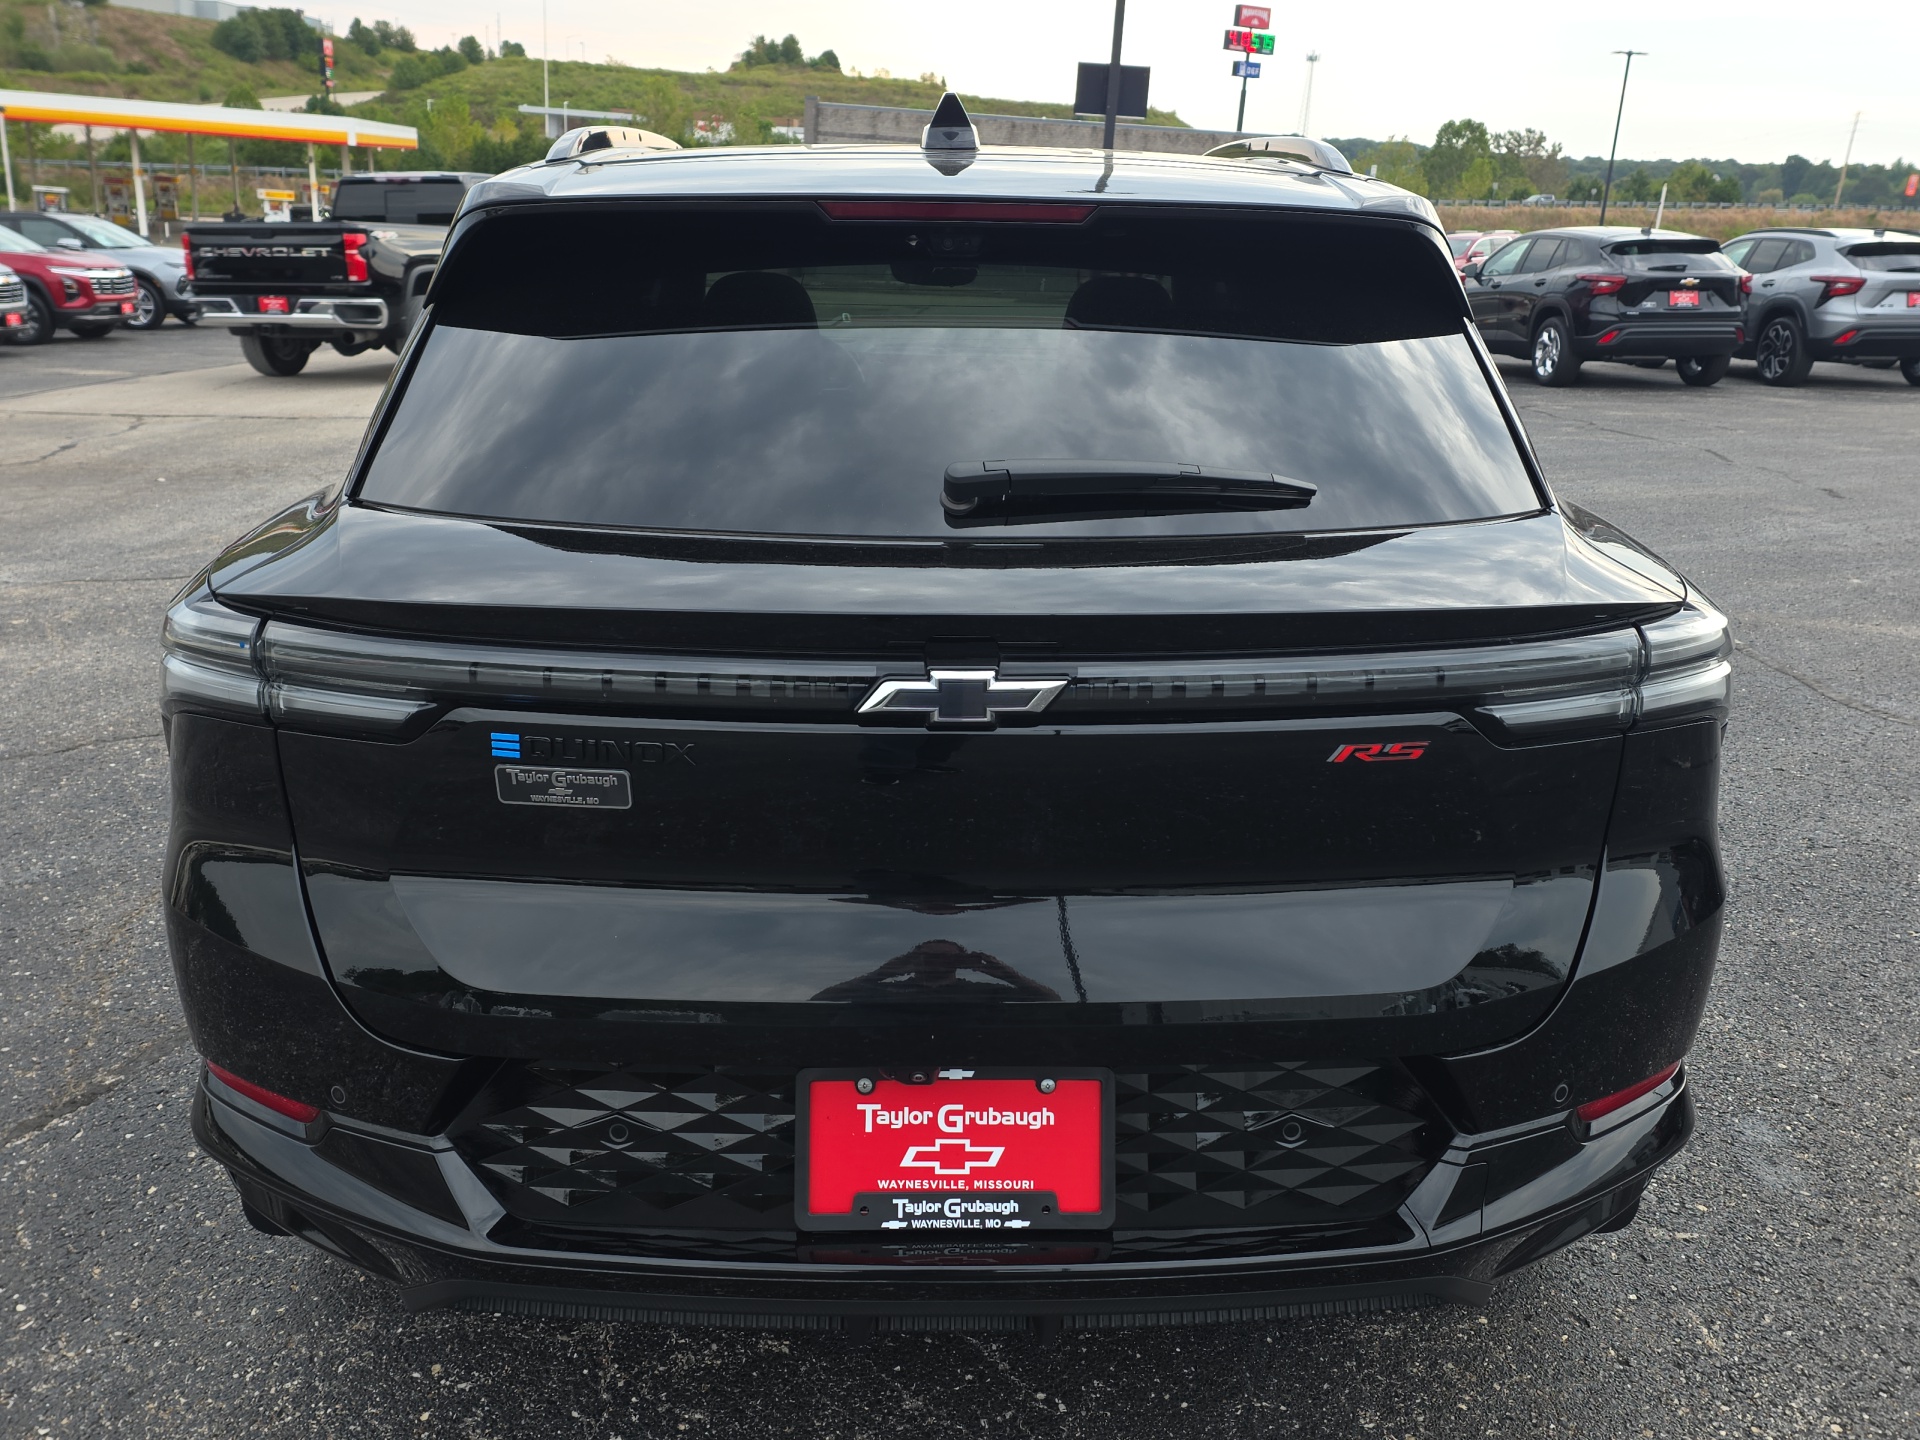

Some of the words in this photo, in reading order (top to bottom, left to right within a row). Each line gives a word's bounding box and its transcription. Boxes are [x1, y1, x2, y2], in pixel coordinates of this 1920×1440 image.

[199, 247, 332, 257] CHEVROLET
[1326, 741, 1431, 763] RS
[505, 768, 549, 785] Taylor
[551, 771, 618, 787] Grubaugh
[530, 794, 586, 804] WAYNESVILLE,
[587, 796, 600, 805] MO
[856, 1103, 933, 1133] Taylor
[937, 1104, 1055, 1133] Grubaugh
[877, 1179, 969, 1191] WAYNESVILLE,
[973, 1179, 1034, 1190] MISSOURI
[892, 1198, 942, 1218] Taylor
[943, 1198, 1019, 1218] Grubaugh
[911, 1219, 983, 1229] WAYNESVILLE,
[985, 1219, 1001, 1228] MO
